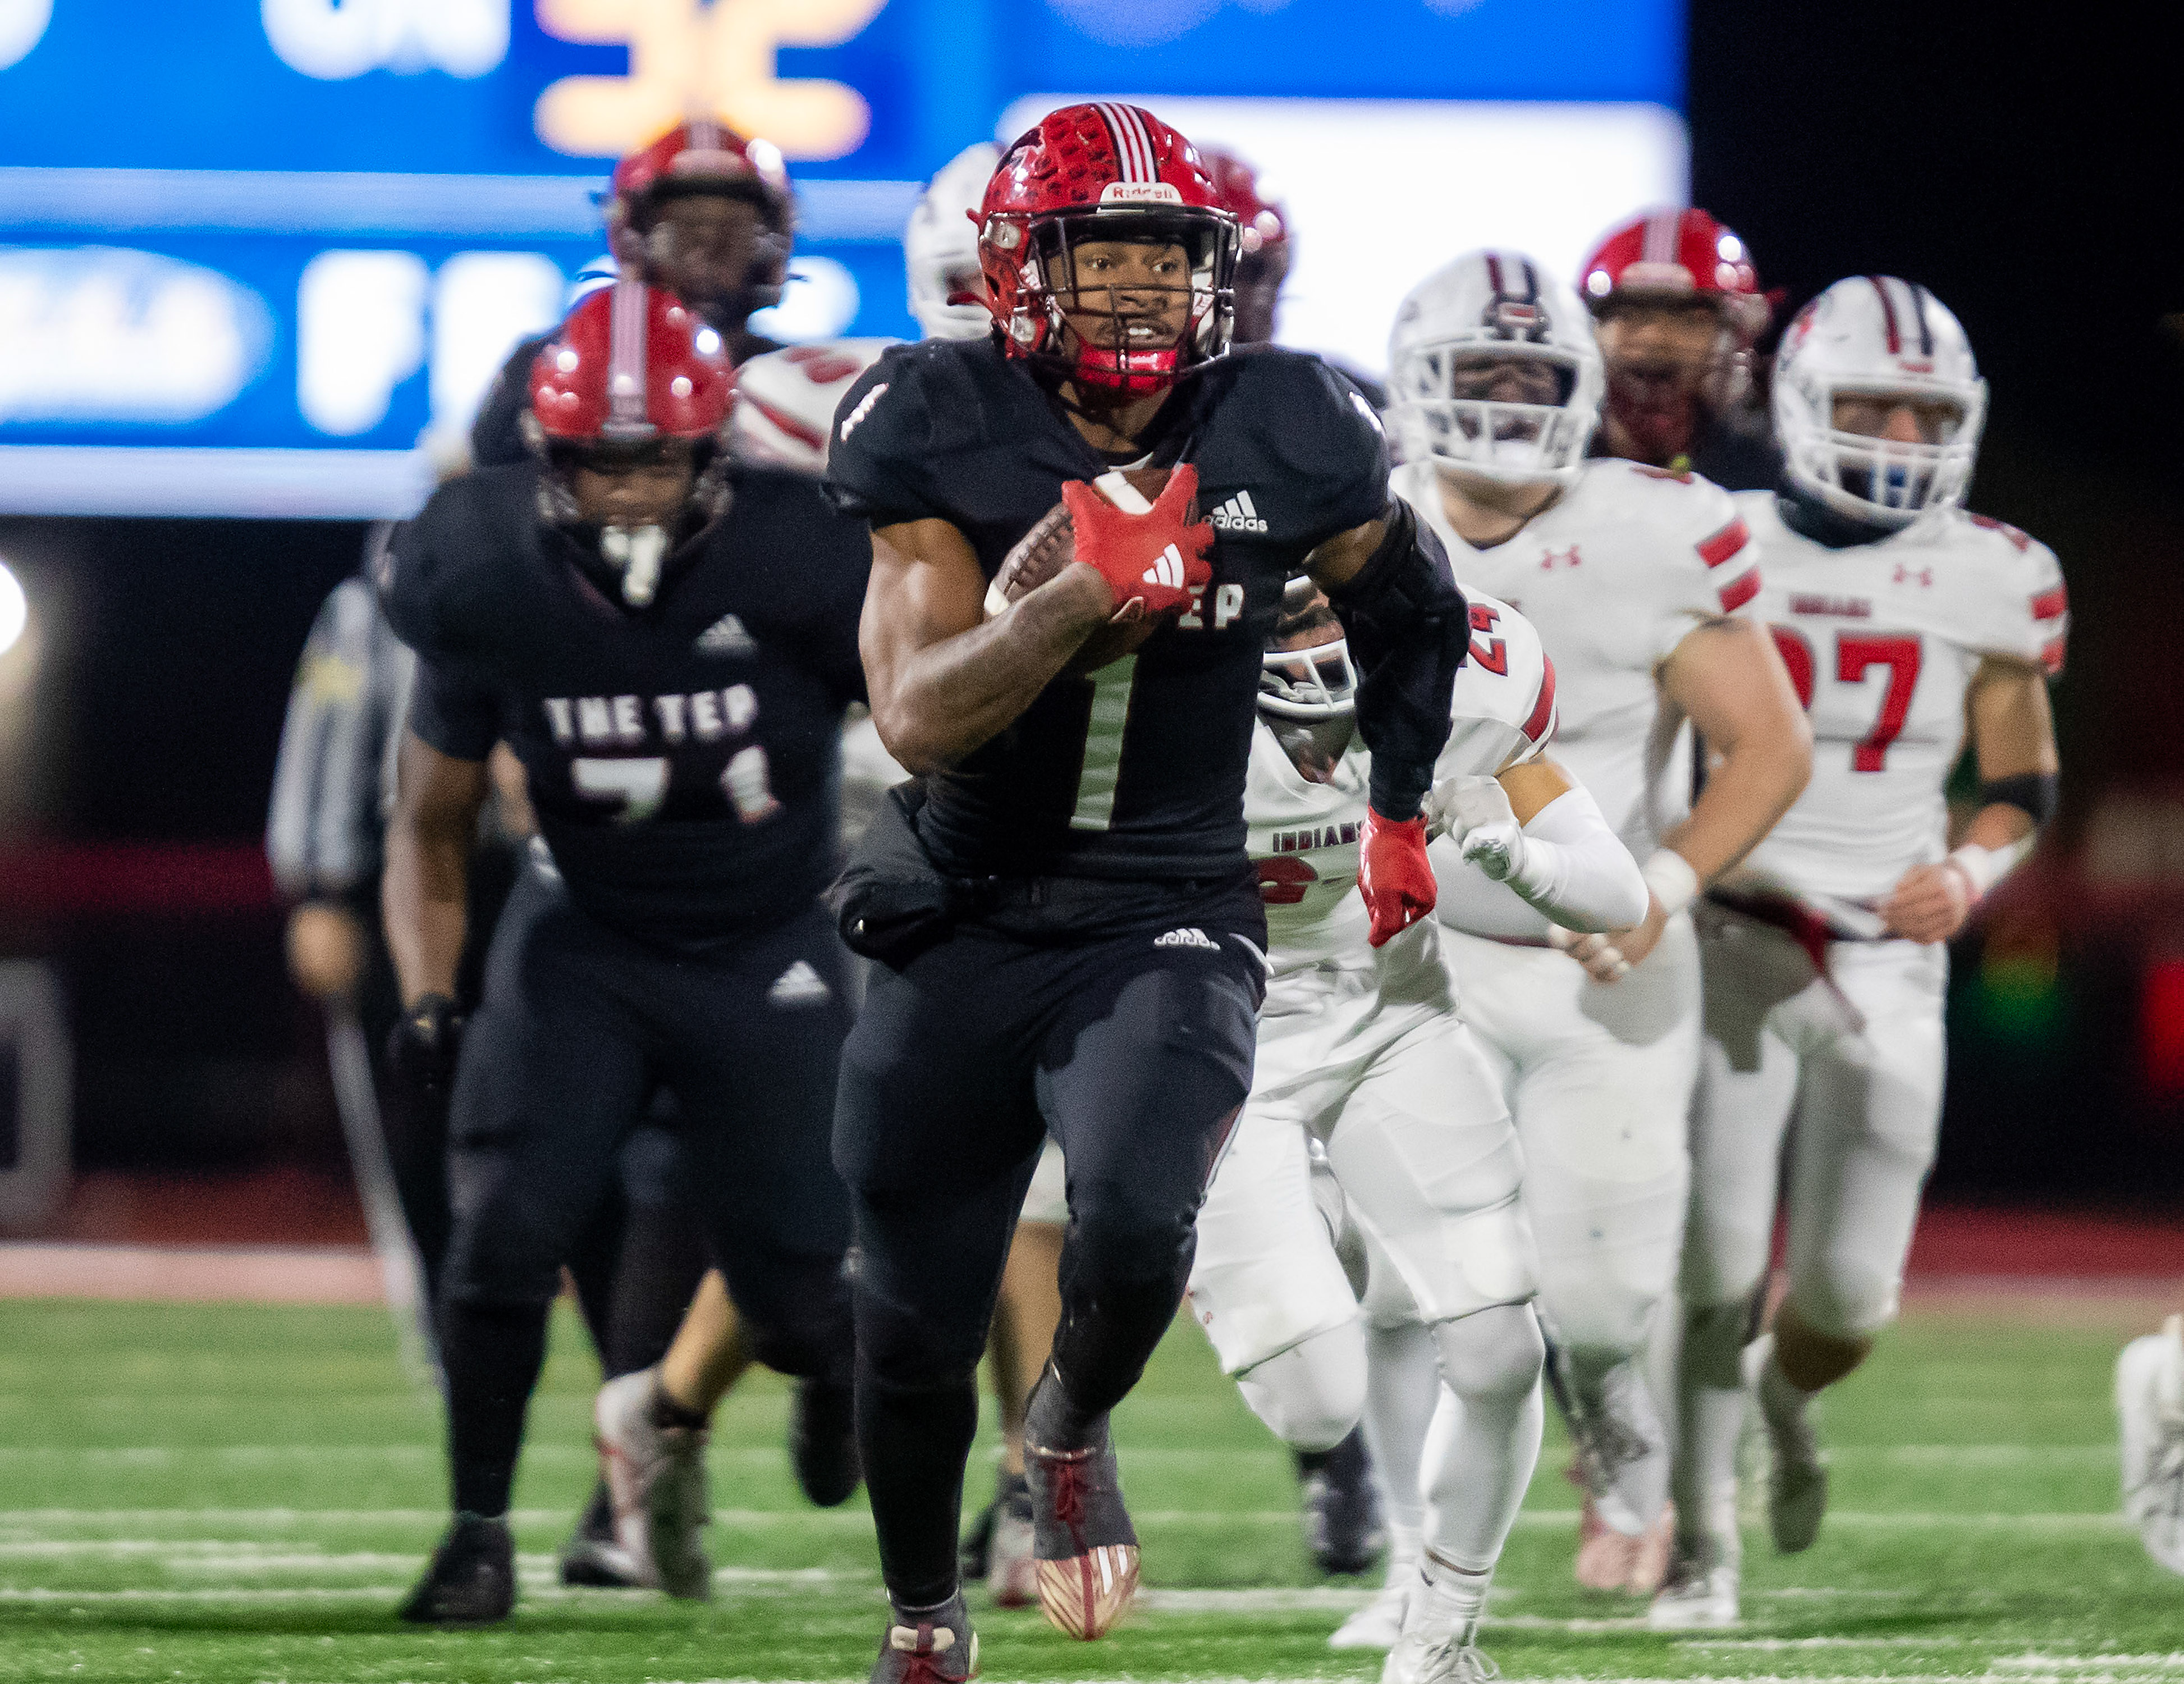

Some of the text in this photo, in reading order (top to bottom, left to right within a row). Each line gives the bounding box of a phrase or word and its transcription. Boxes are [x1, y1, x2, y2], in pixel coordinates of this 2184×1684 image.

[1178, 583, 1245, 630] EP
[543, 695, 644, 743] THE
[1070, 653, 1138, 830] 1
